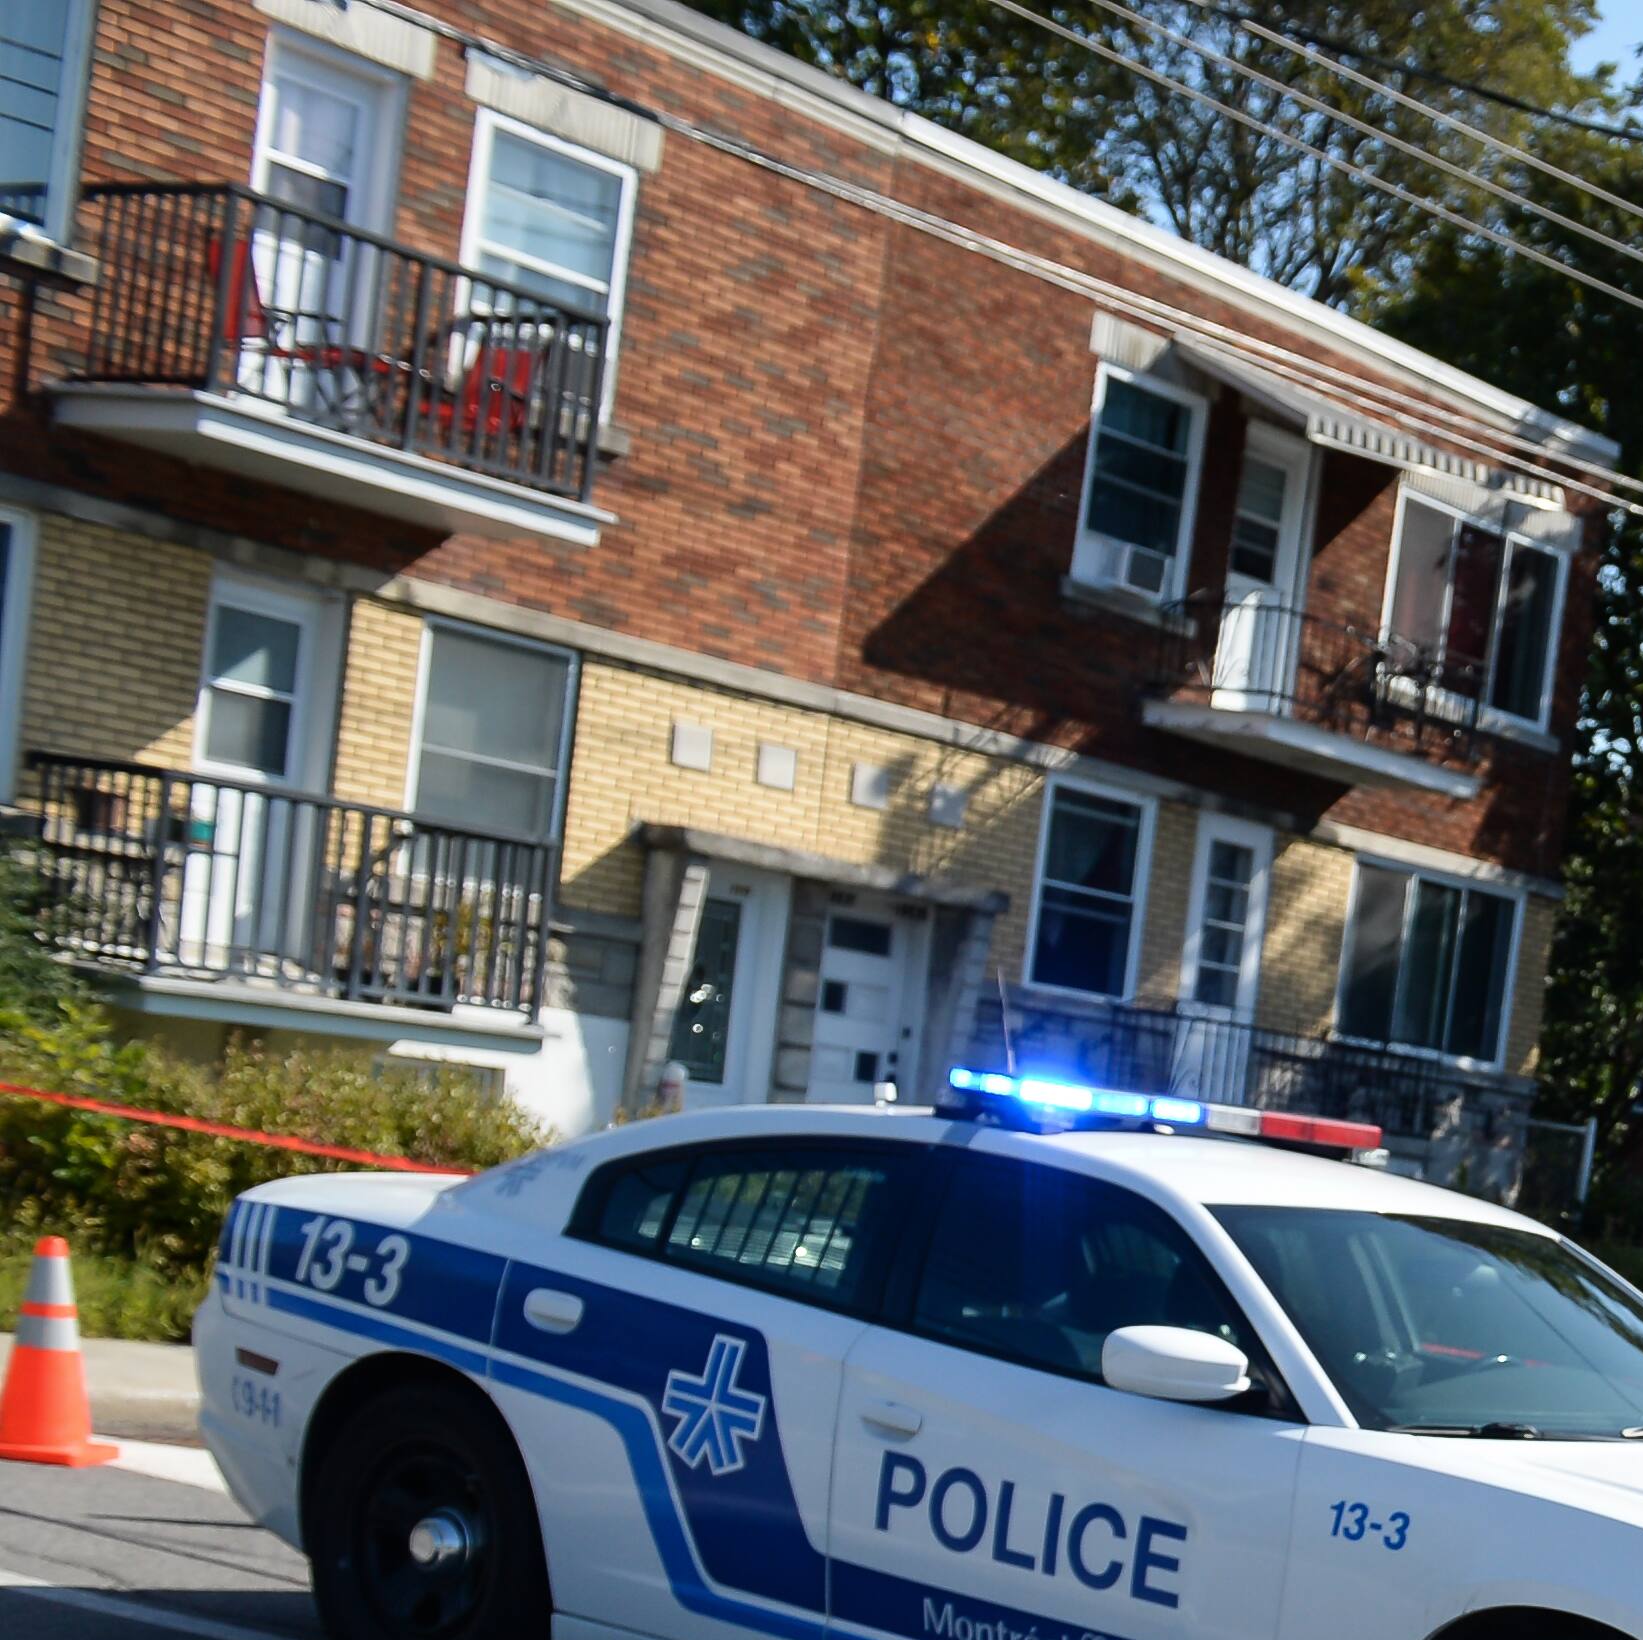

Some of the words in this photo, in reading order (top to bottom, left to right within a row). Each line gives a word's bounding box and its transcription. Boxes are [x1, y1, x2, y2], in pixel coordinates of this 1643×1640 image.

[294, 1214, 411, 1307] 13-3
[874, 1450, 1188, 1608] POLICE
[1328, 1500, 1410, 1551] 13-3
